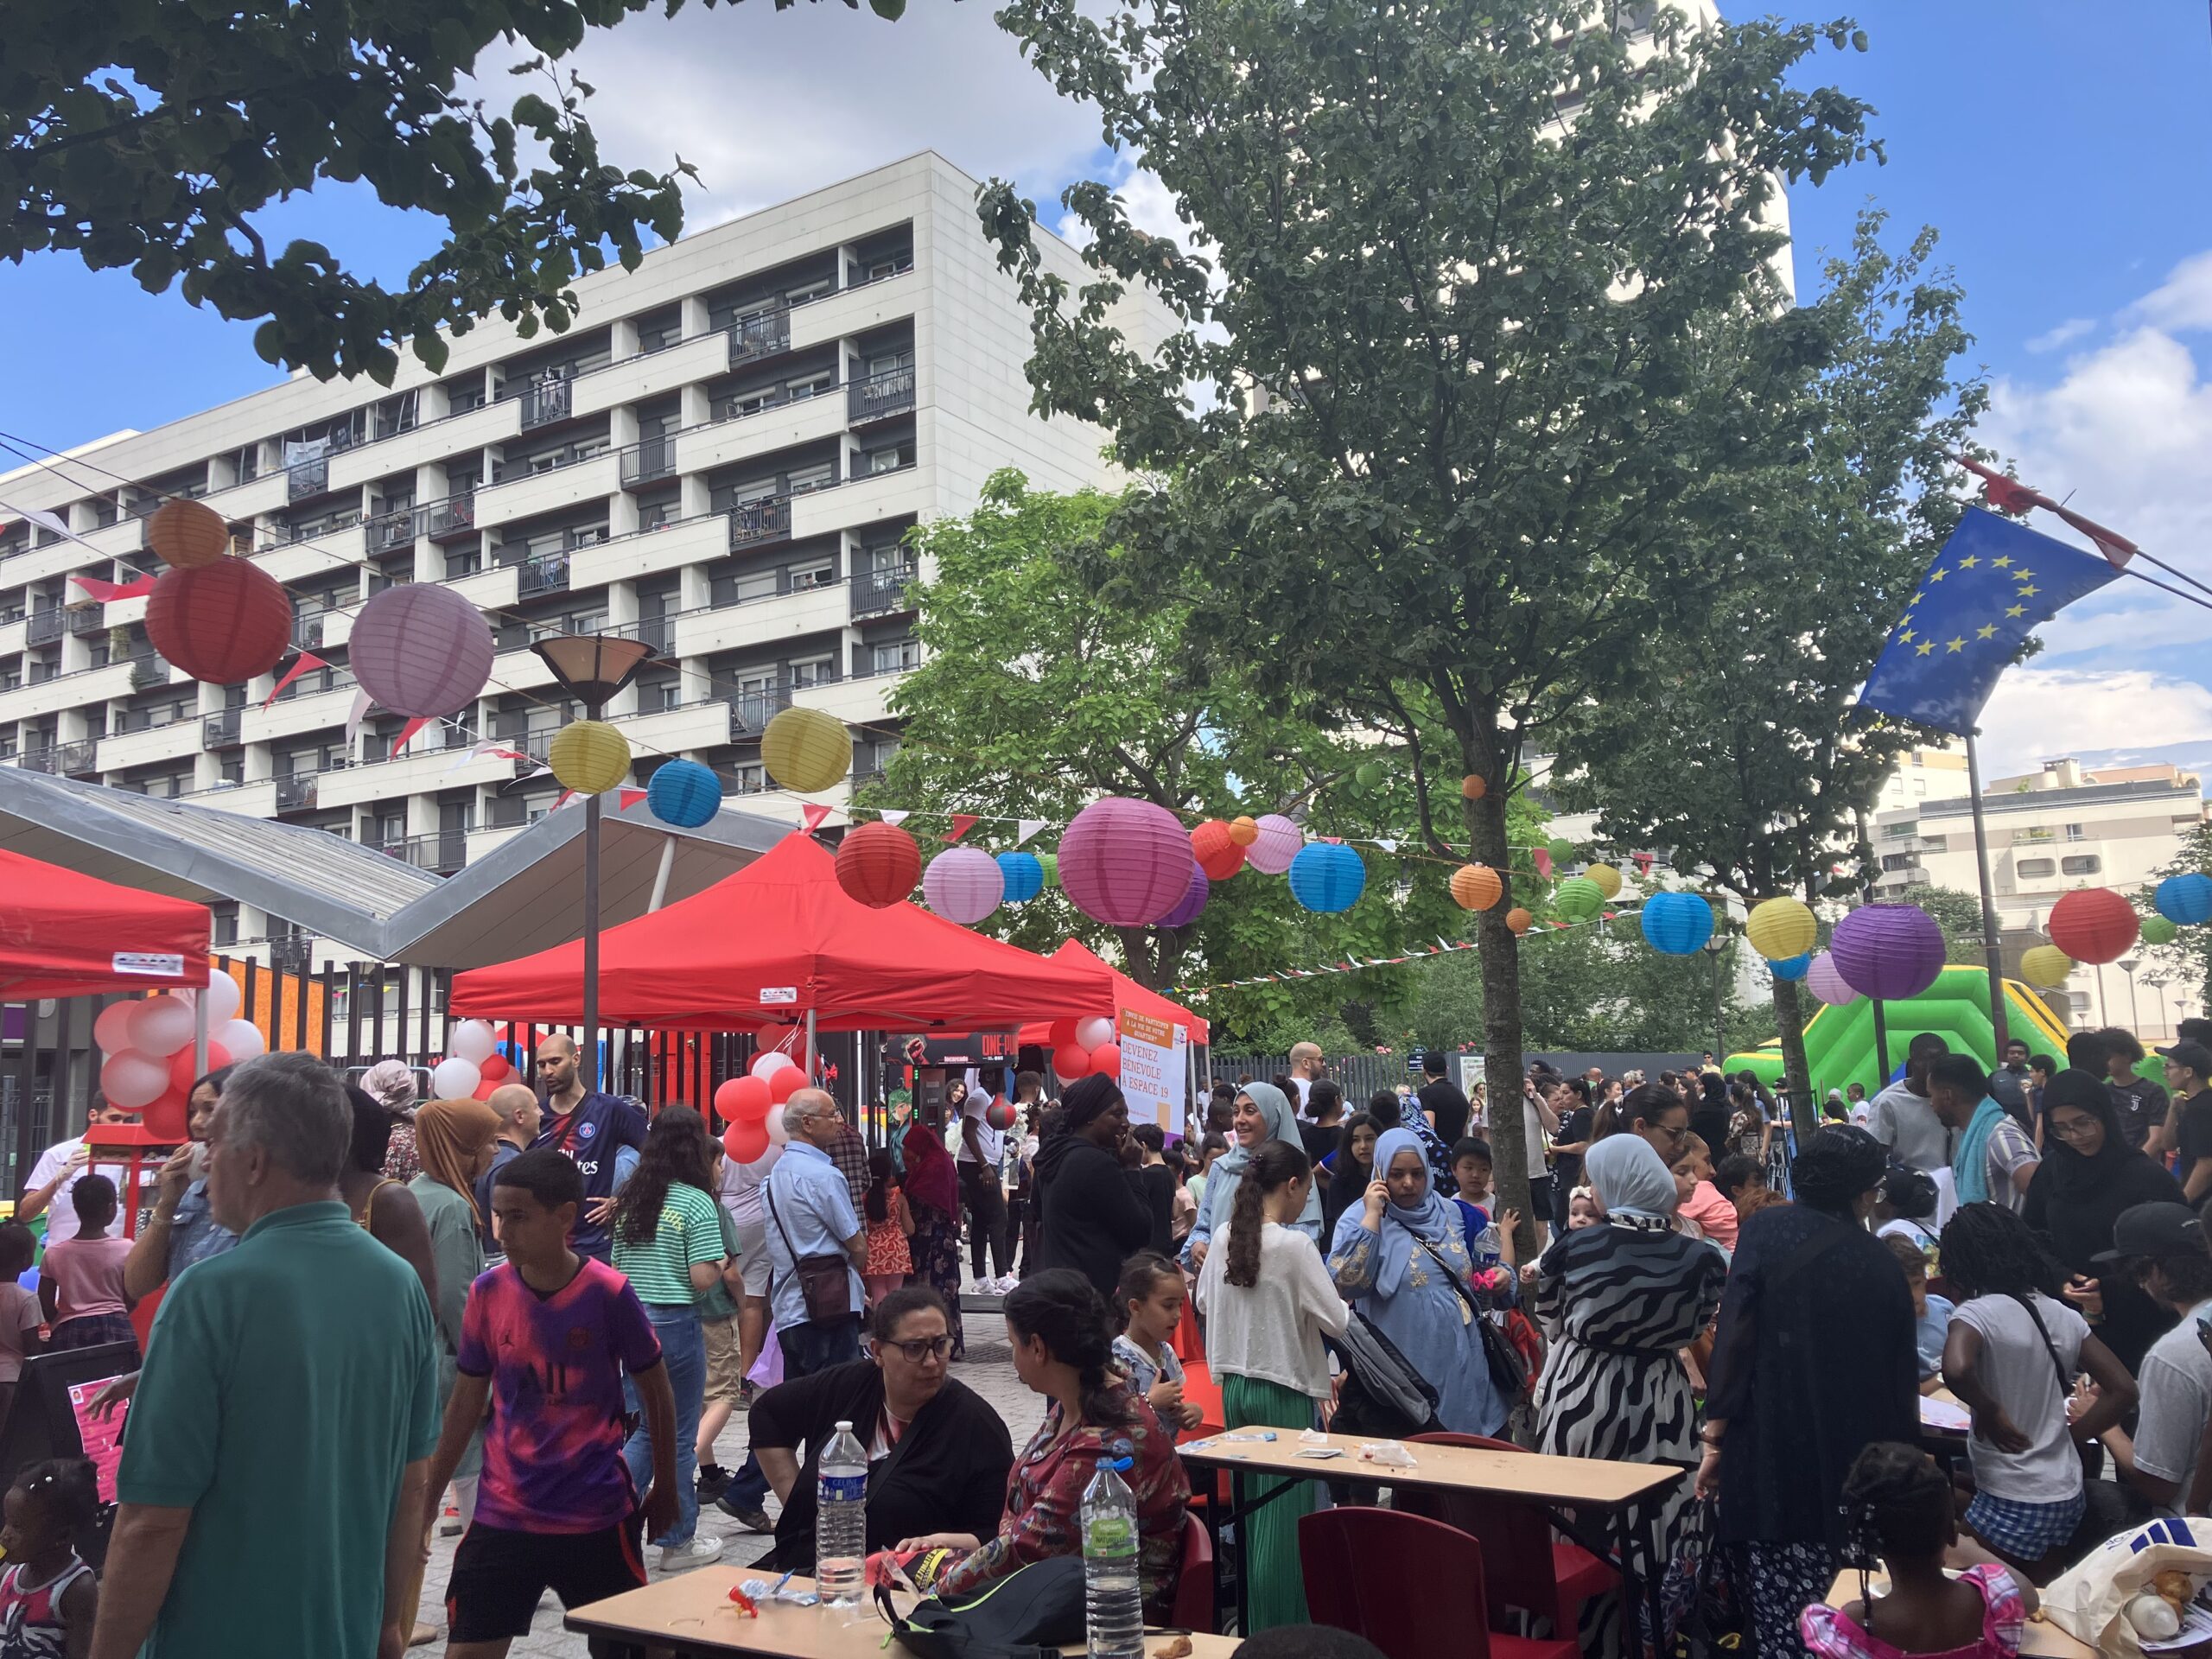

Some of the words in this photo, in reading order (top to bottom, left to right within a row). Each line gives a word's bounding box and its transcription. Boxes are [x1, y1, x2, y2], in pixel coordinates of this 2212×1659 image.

[1145, 1017, 1169, 1029] PARTICIPER
[1122, 1040, 1158, 1062] DEVENEZ
[1122, 1056, 1161, 1080] BÉNÉVOLE
[1128, 1077, 1159, 1096] ESPACE
[1160, 1086, 1168, 1098] 19
